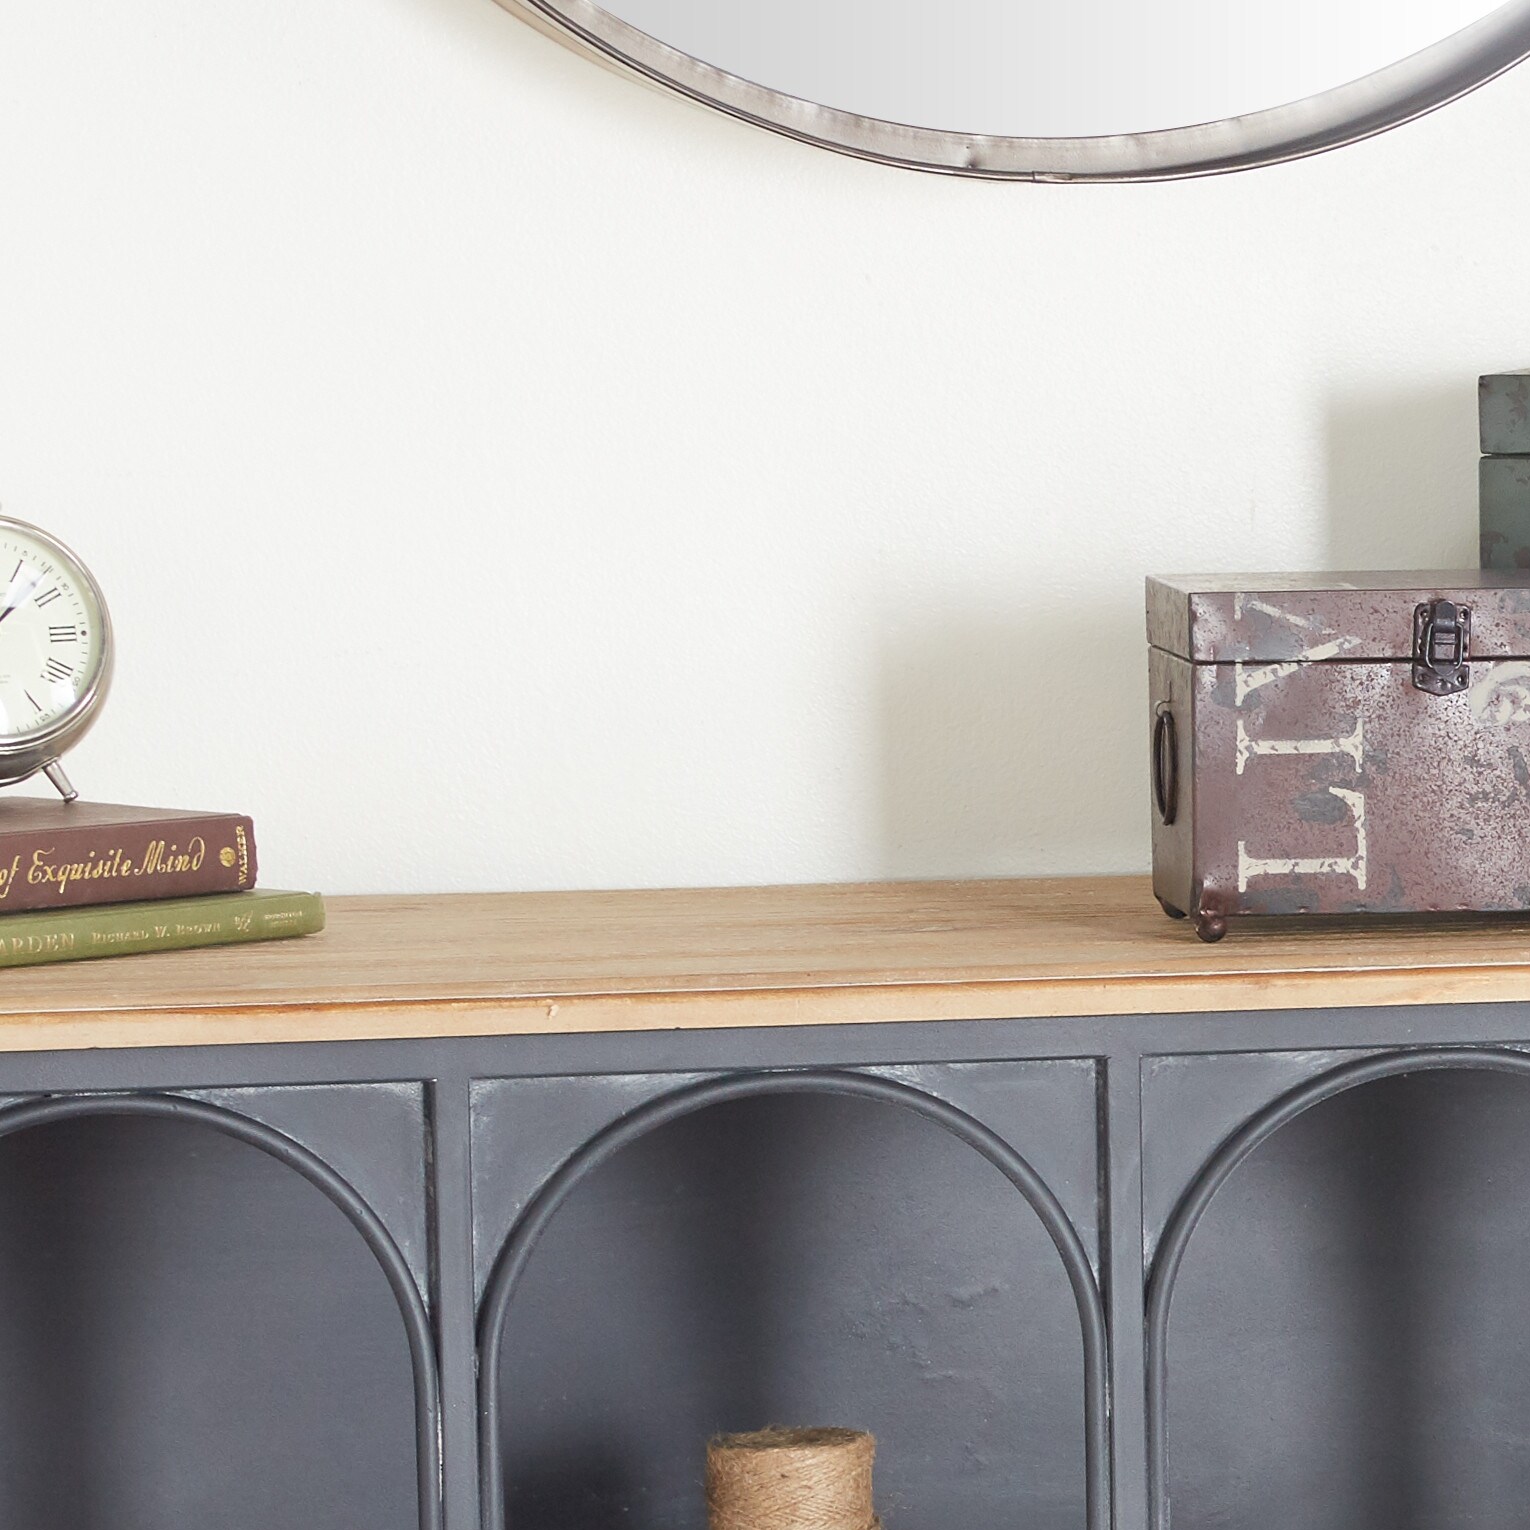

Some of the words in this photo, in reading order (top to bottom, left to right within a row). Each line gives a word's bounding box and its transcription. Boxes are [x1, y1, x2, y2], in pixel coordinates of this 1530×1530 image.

[48, 625, 77, 643] III
[28, 847, 132, 894] Exquisite
[134, 836, 205, 876] Mind
[235, 825, 248, 885] WALKER
